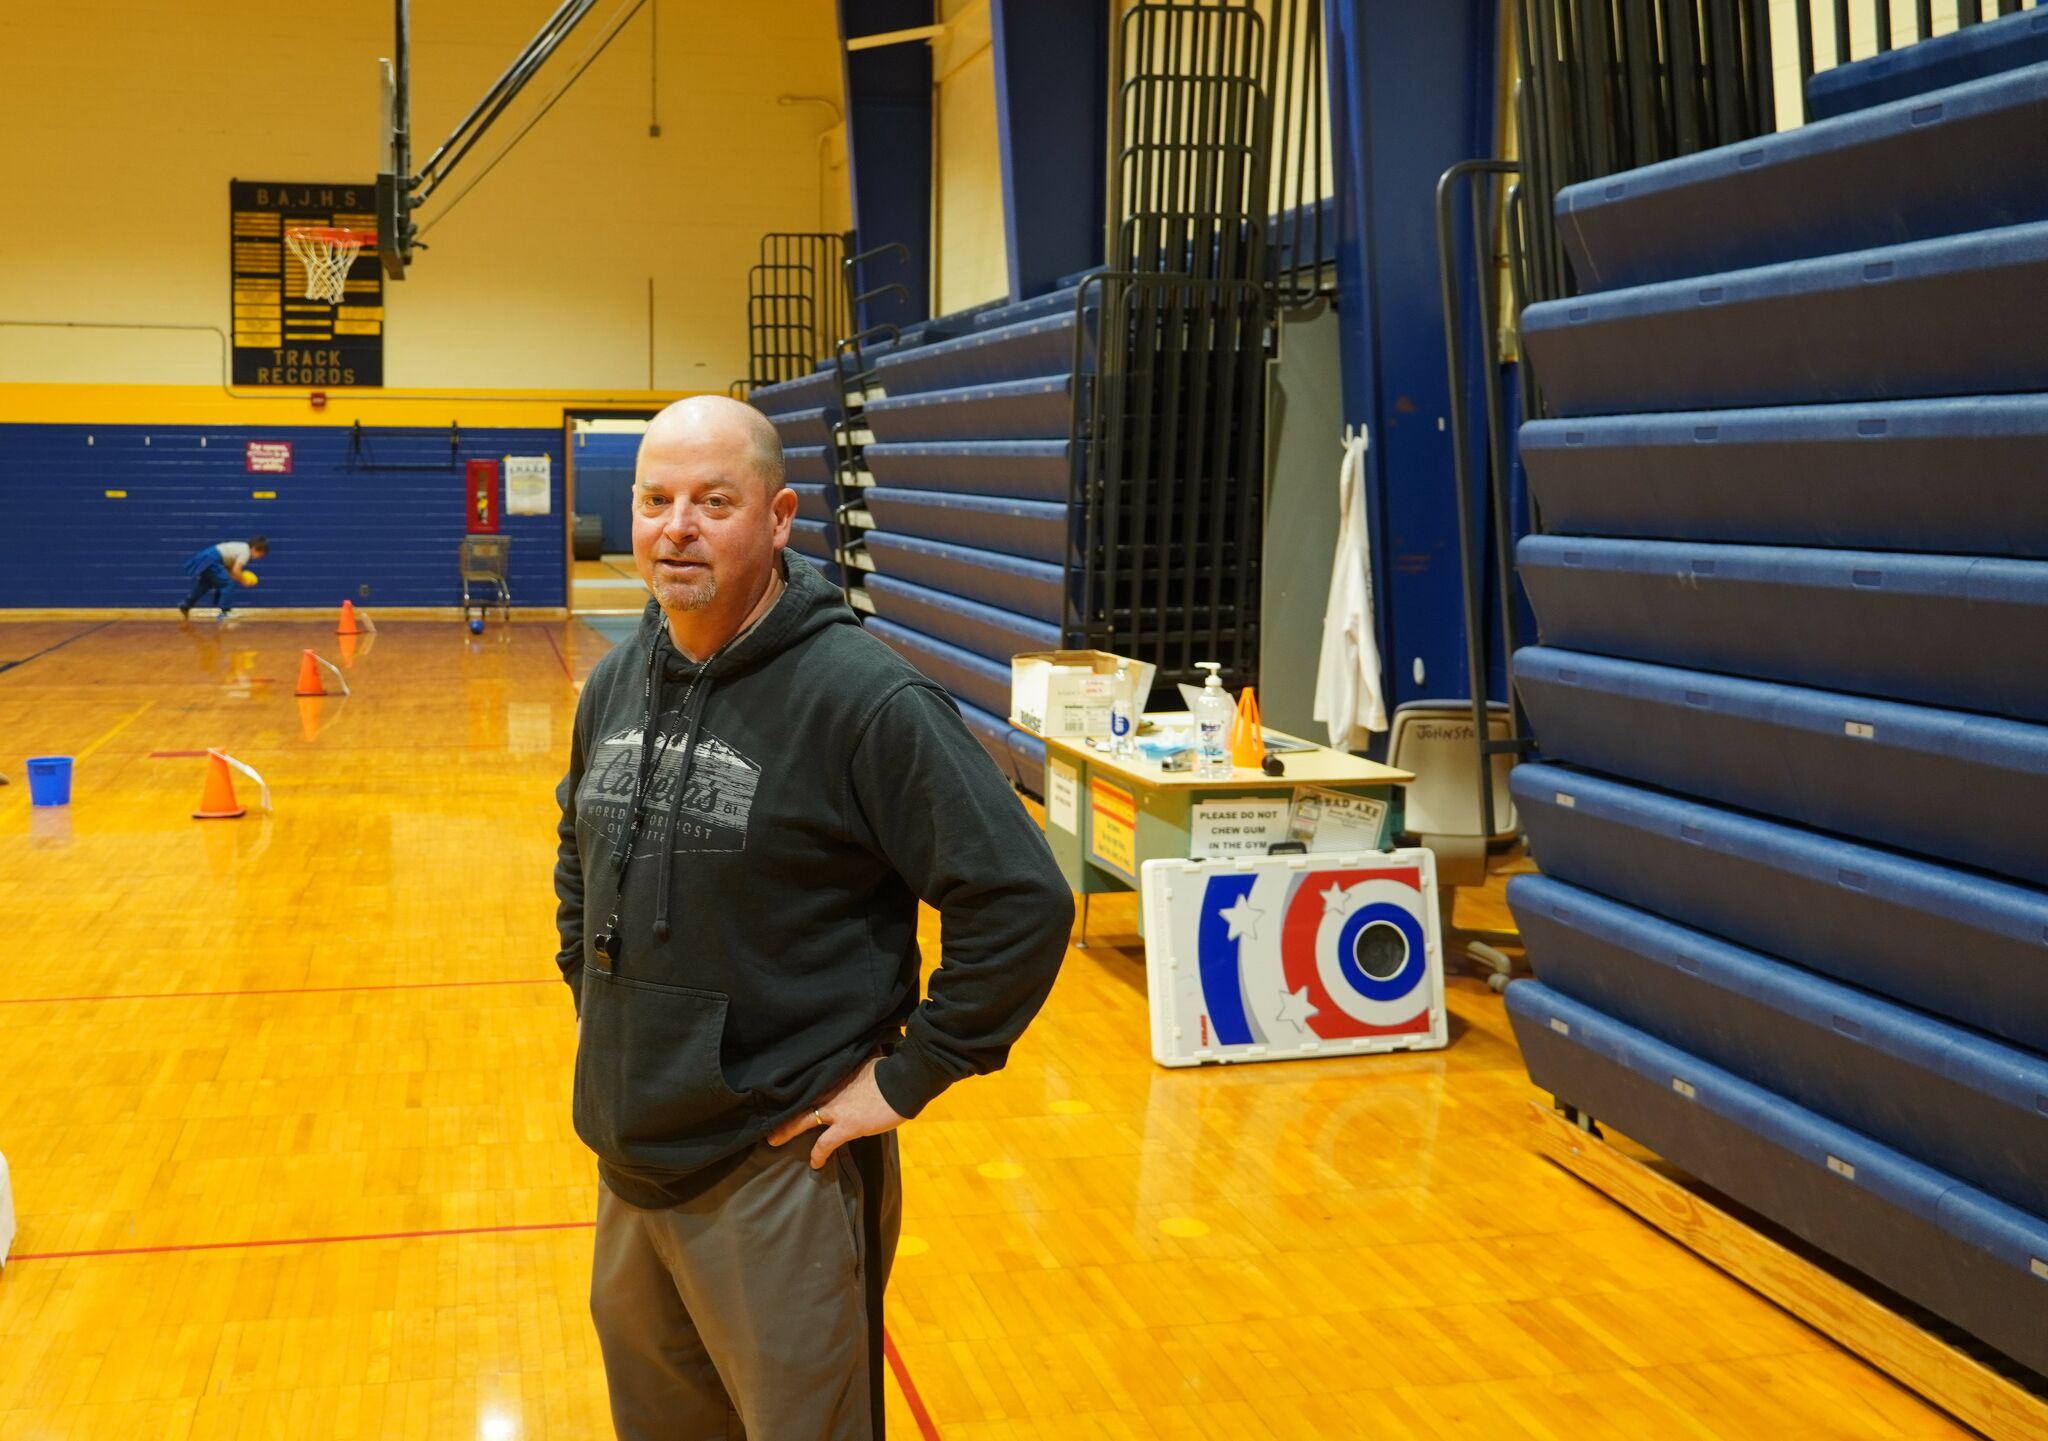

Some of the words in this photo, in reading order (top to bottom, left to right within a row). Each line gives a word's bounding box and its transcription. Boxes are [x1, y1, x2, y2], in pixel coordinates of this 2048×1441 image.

[273, 350, 341, 367] TRACK
[257, 367, 356, 385] RECORDS
[597, 748, 720, 813] Caela's
[723, 802, 738, 816] 61
[1200, 811, 1238, 819] PLEASE
[1240, 811, 1255, 819] DO
[1257, 811, 1277, 819] NOT
[1324, 797, 1351, 808] BAD
[1354, 801, 1380, 818] AXE
[643, 812, 712, 840] OROST
[1243, 826, 1266, 834] GUM
[1223, 841, 1242, 849] THE
[1245, 841, 1267, 849] GYM
